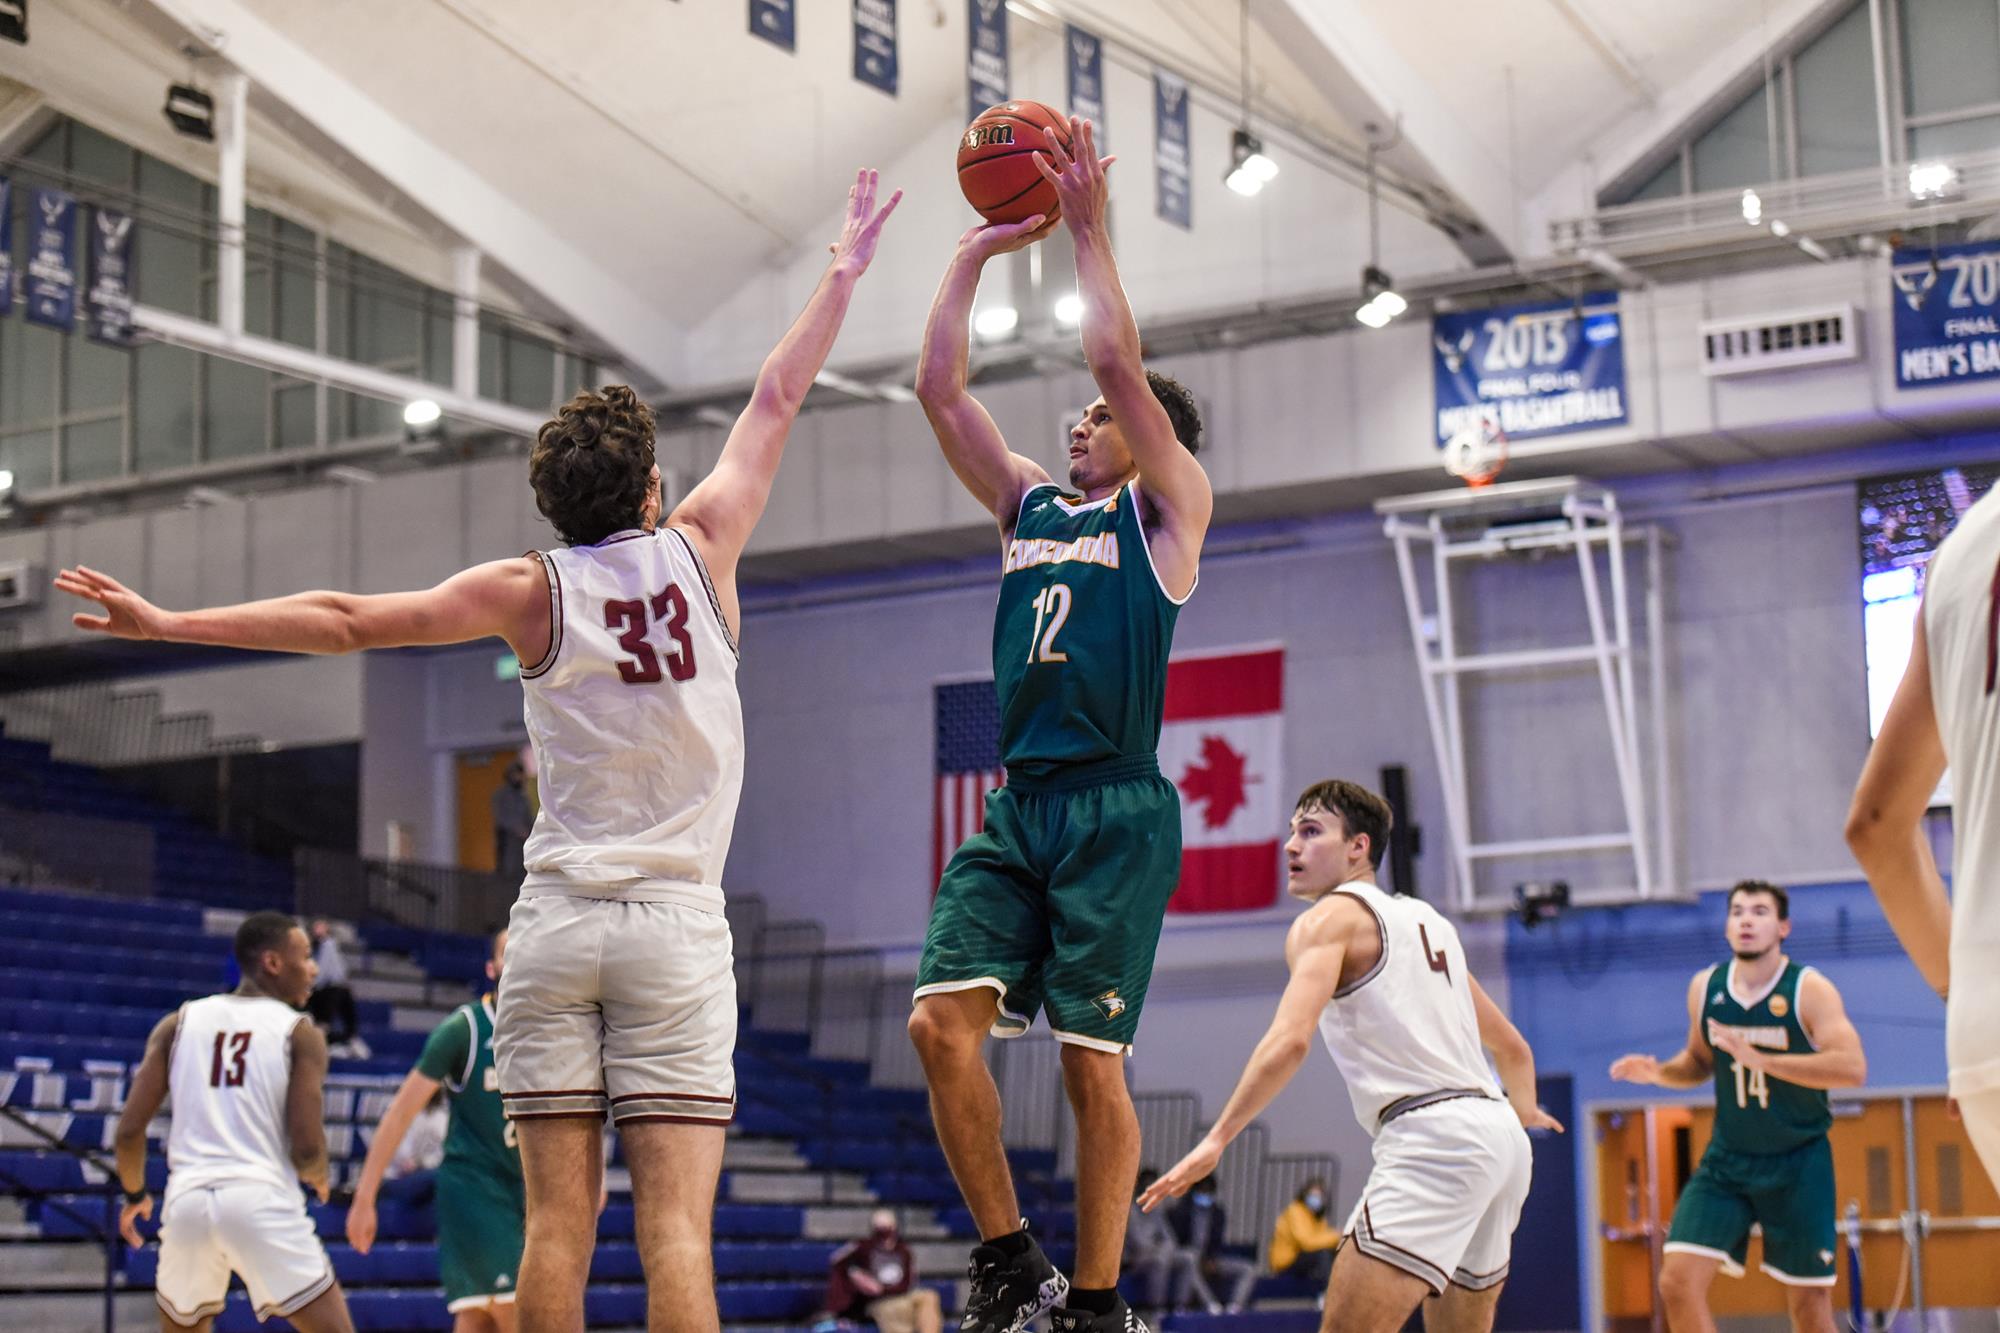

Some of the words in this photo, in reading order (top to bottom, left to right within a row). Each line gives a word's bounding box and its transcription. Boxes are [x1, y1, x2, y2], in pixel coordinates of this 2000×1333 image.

[1948, 253, 2000, 308] 20
[1944, 316, 2000, 338] FINAL
[1901, 343, 1969, 381] MEN'S
[1970, 339, 2000, 373] BA
[604, 583, 697, 683] 33
[1027, 583, 1072, 664] 12
[210, 1031, 252, 1088] 13
[1731, 1061, 1769, 1109] 14
